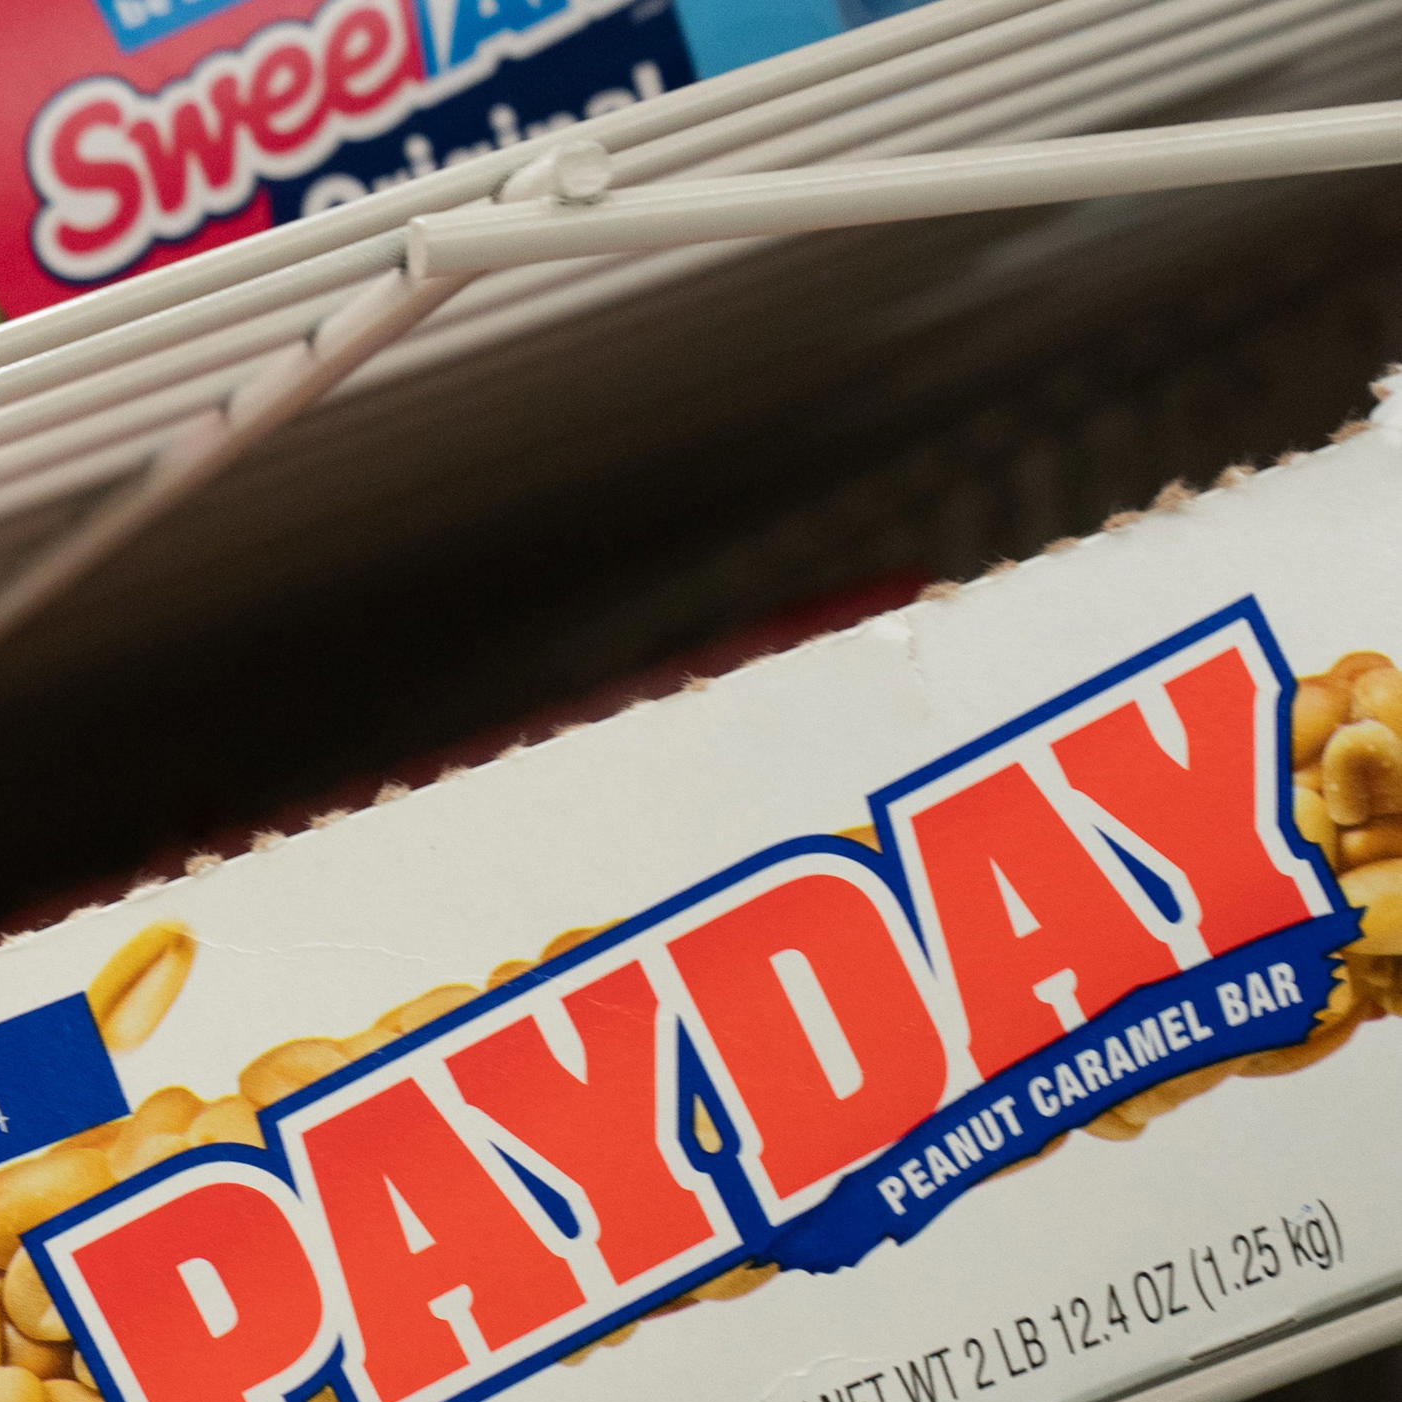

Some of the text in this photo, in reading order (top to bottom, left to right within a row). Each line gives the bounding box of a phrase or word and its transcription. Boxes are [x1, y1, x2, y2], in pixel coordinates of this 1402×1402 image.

[876, 961, 1304, 1216] PEANUT CARAMEL BAR
[963, 1336, 998, 1392] 2
[994, 1314, 1049, 1378] LB
[1050, 1282, 1131, 1356] 12.4
[1132, 1260, 1190, 1326] OZ
[1188, 1224, 1284, 1313] (1.25
[1282, 1197, 1346, 1271] kg)
